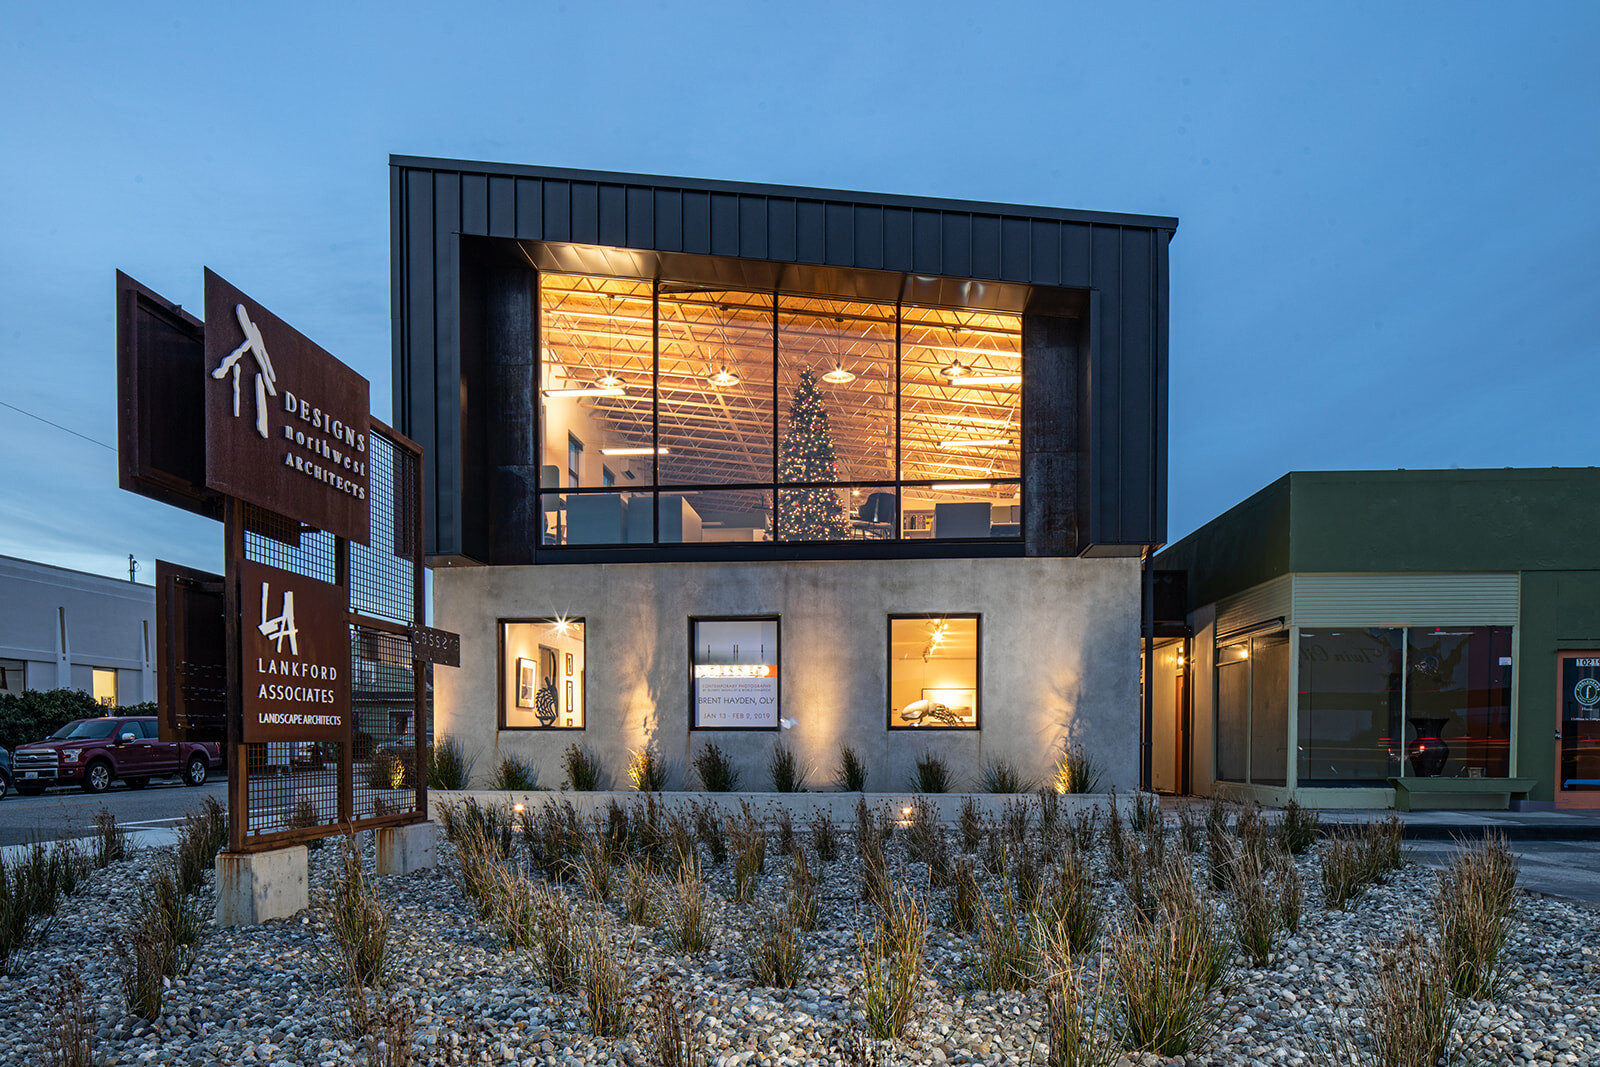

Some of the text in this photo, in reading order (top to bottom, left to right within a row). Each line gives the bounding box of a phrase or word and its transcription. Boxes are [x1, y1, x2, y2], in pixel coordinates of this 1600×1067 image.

[284, 390, 365, 452] DESIGNS
[284, 425, 365, 476] northwest
[284, 452, 365, 500] ARCHITECTS
[258, 657, 337, 681] LANKFORD
[258, 684, 335, 704] ASSOCIATES
[697, 696, 775, 706] BRENT HAYDEN, OLY
[258, 712, 342, 726] LANDSCAPE ARCHITECTS
[703, 712, 717, 720] JAN
[719, 712, 727, 720] 13
[732, 712, 745, 720] FEB
[754, 712, 771, 720] 2019
